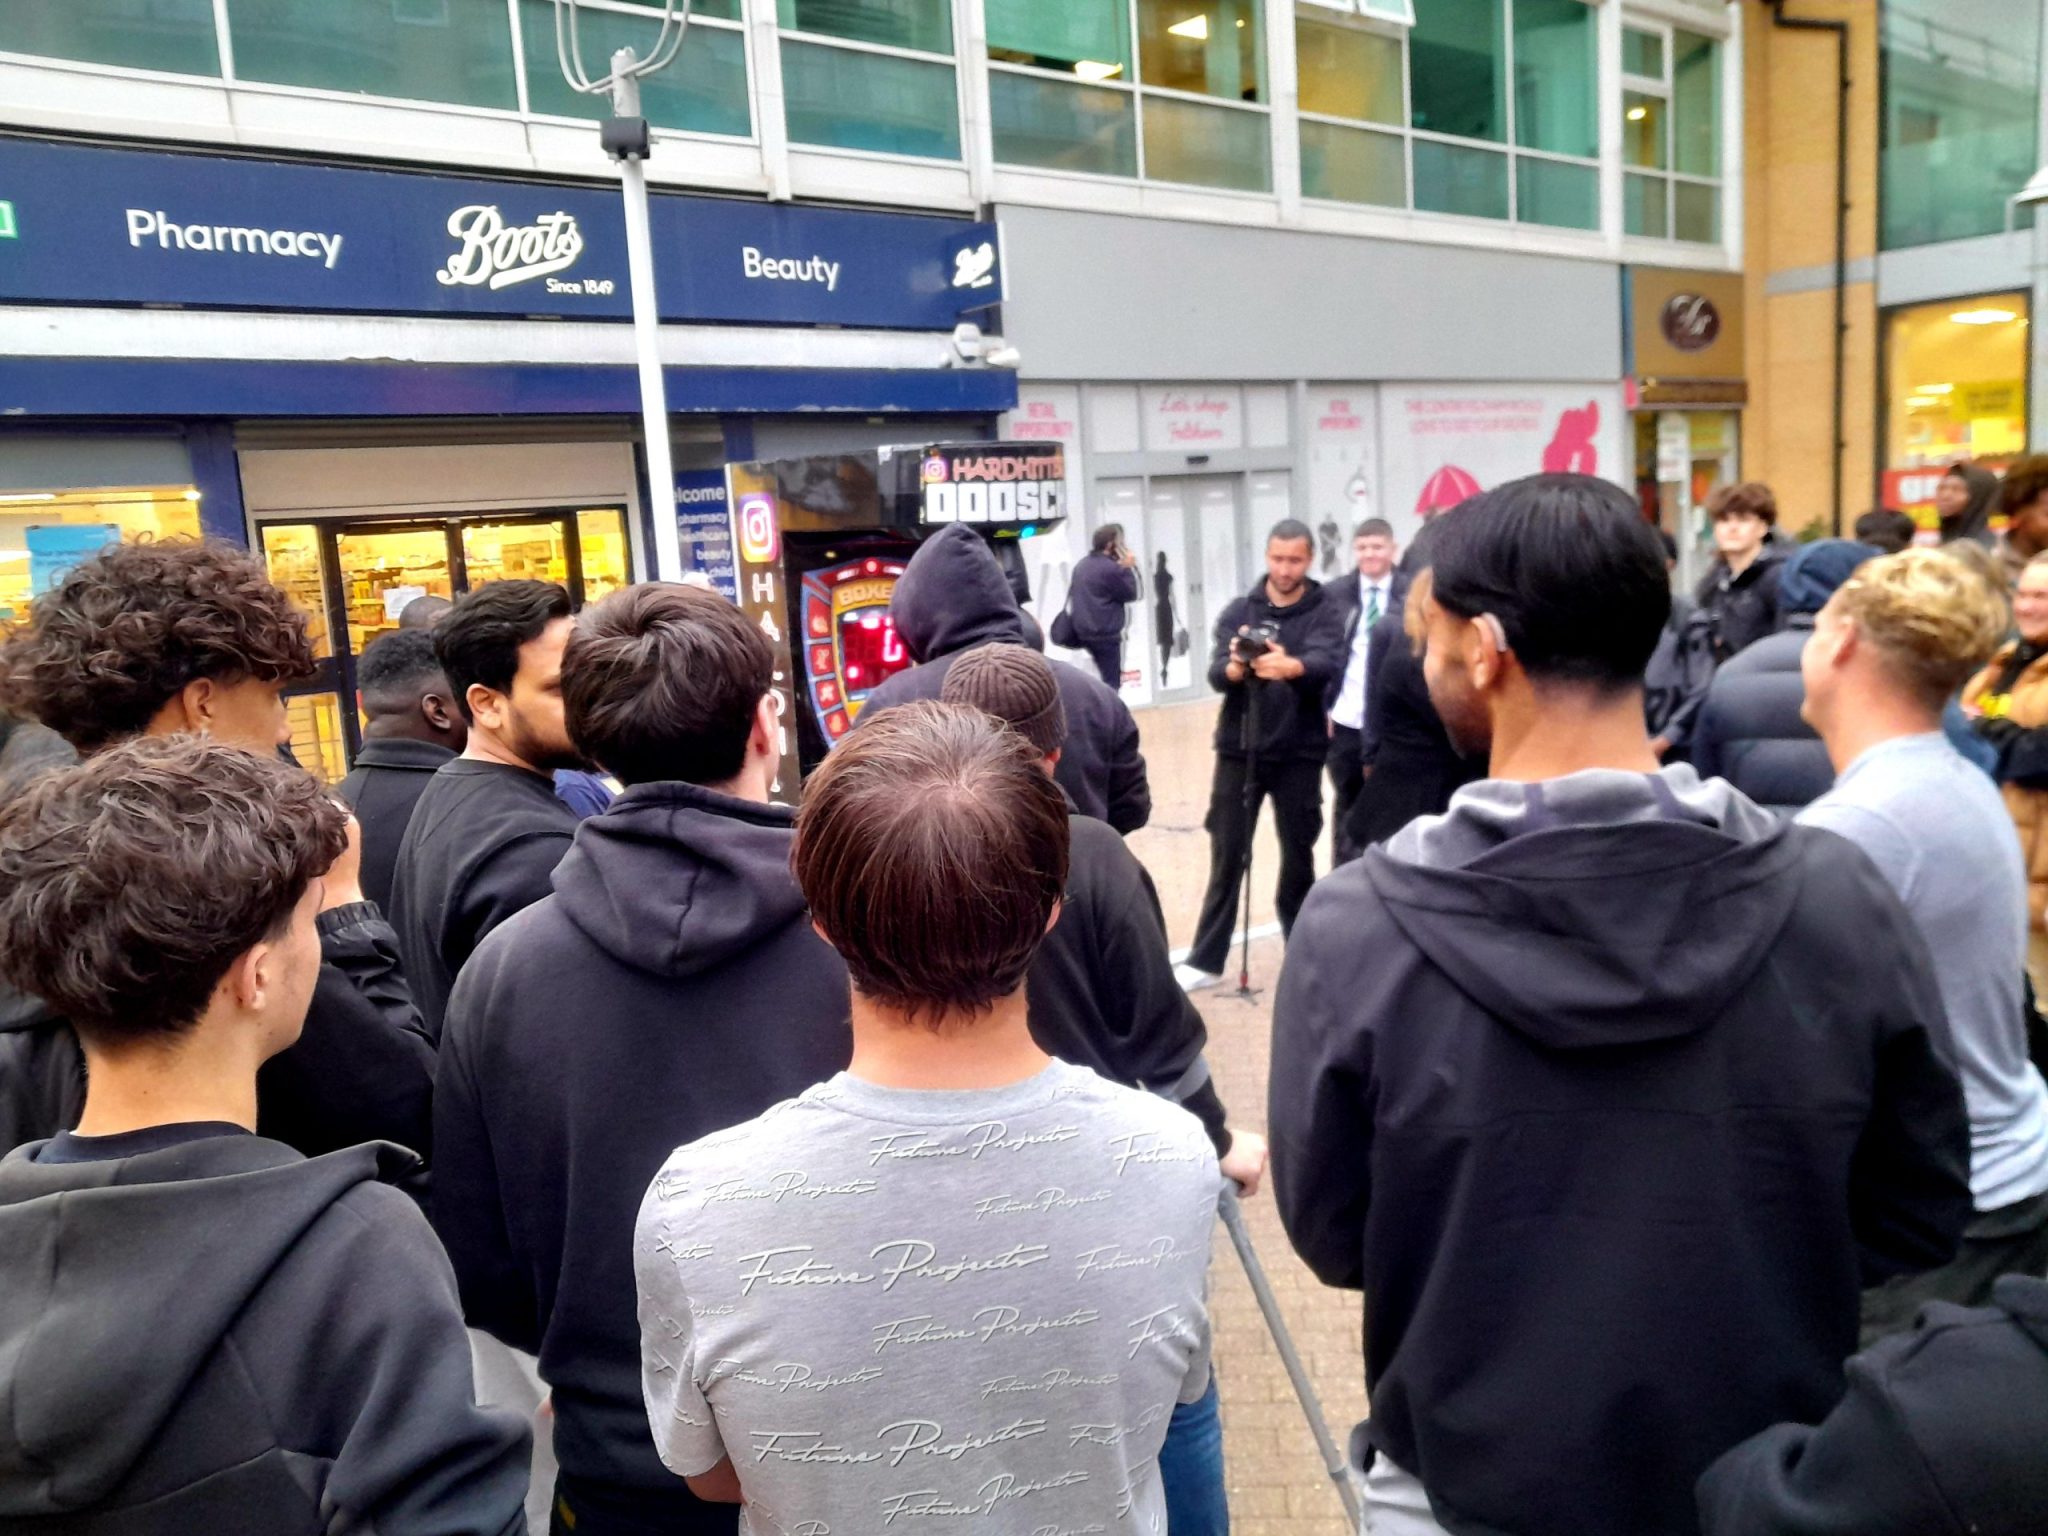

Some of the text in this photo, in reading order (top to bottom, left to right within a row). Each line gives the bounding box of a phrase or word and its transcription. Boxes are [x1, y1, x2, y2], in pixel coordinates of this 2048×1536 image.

[126, 208, 343, 269] Pharmacy
[436, 205, 583, 290] Boots
[545, 278, 614, 295] Since 1849
[742, 246, 839, 291] Beauty
[696, 549, 731, 561] beauty
[869, 1121, 1080, 1166] Future Projects
[975, 1187, 1114, 1221] Future Projects
[737, 1239, 1050, 1297] Future Projects
[873, 1306, 1101, 1354] Future Projects
[772, 1362, 884, 1393] Projects
[981, 1368, 1119, 1400] Future Projects
[750, 1419, 1047, 1467] Future Projects
[881, 1490, 981, 1525] Future
[977, 1473, 1089, 1516] Projects
